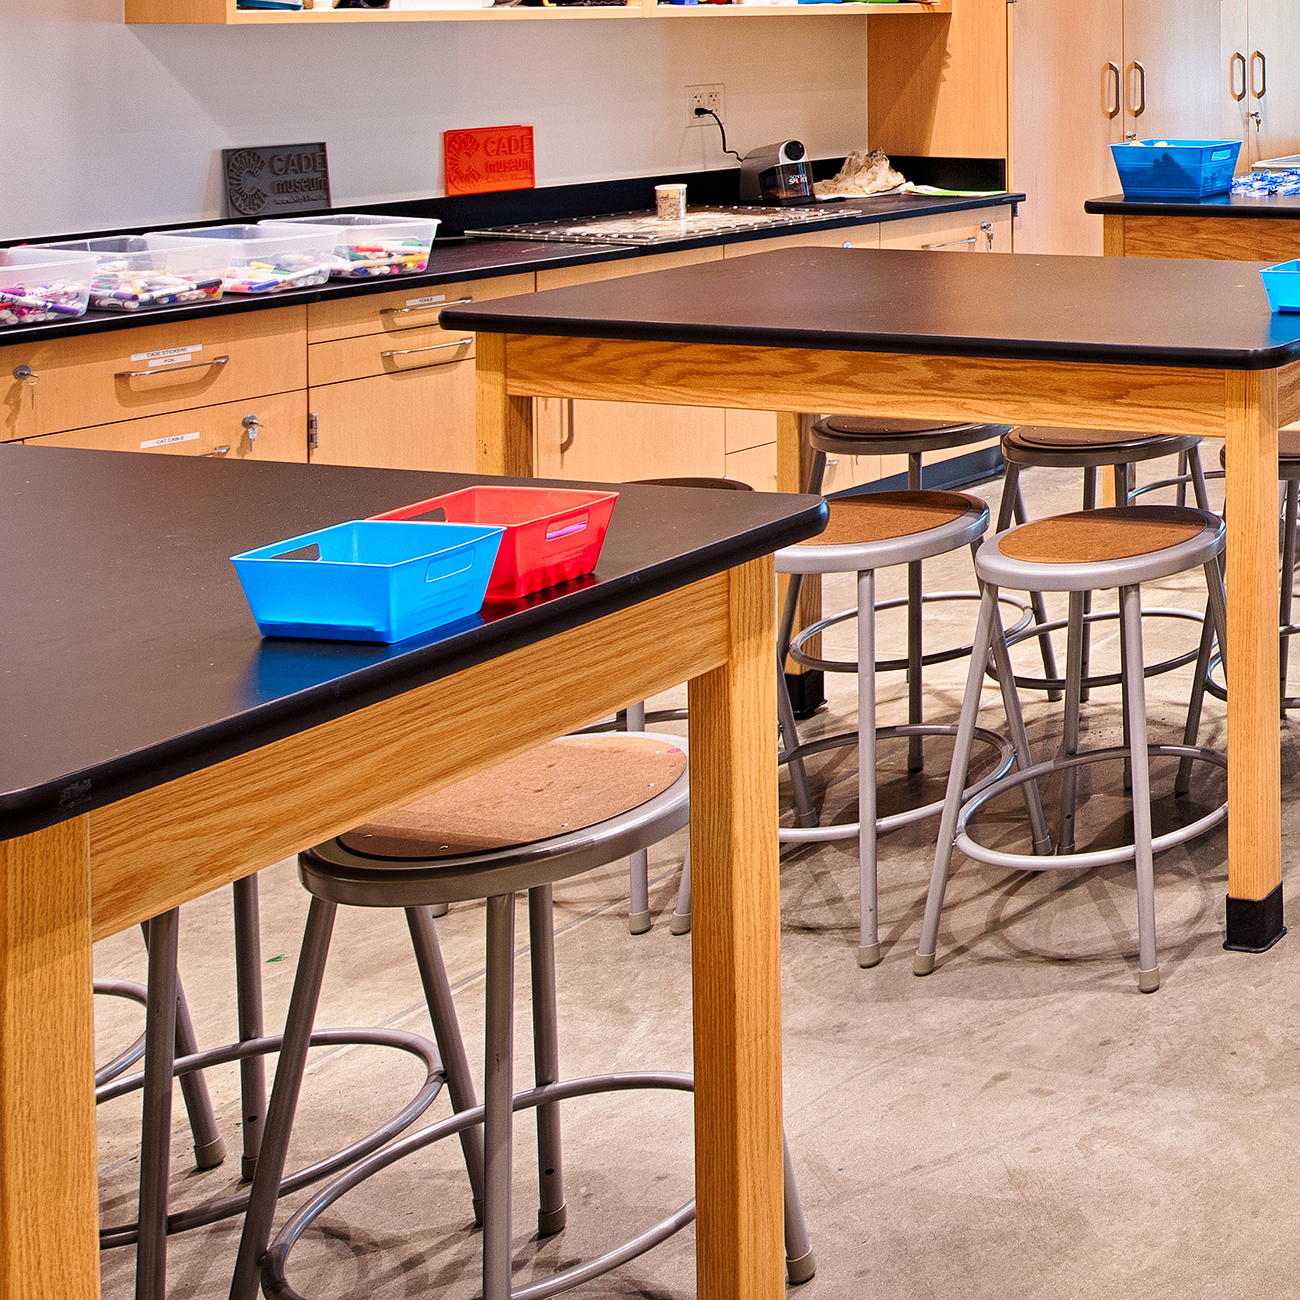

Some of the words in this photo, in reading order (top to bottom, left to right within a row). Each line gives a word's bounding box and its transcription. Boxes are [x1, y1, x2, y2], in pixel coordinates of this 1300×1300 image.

[485, 135, 533, 156] CADE
[270, 152, 327, 175] CADE
[485, 158, 533, 173] museum
[273, 177, 328, 194] museum
[161, 347, 188, 355] STICKERS
